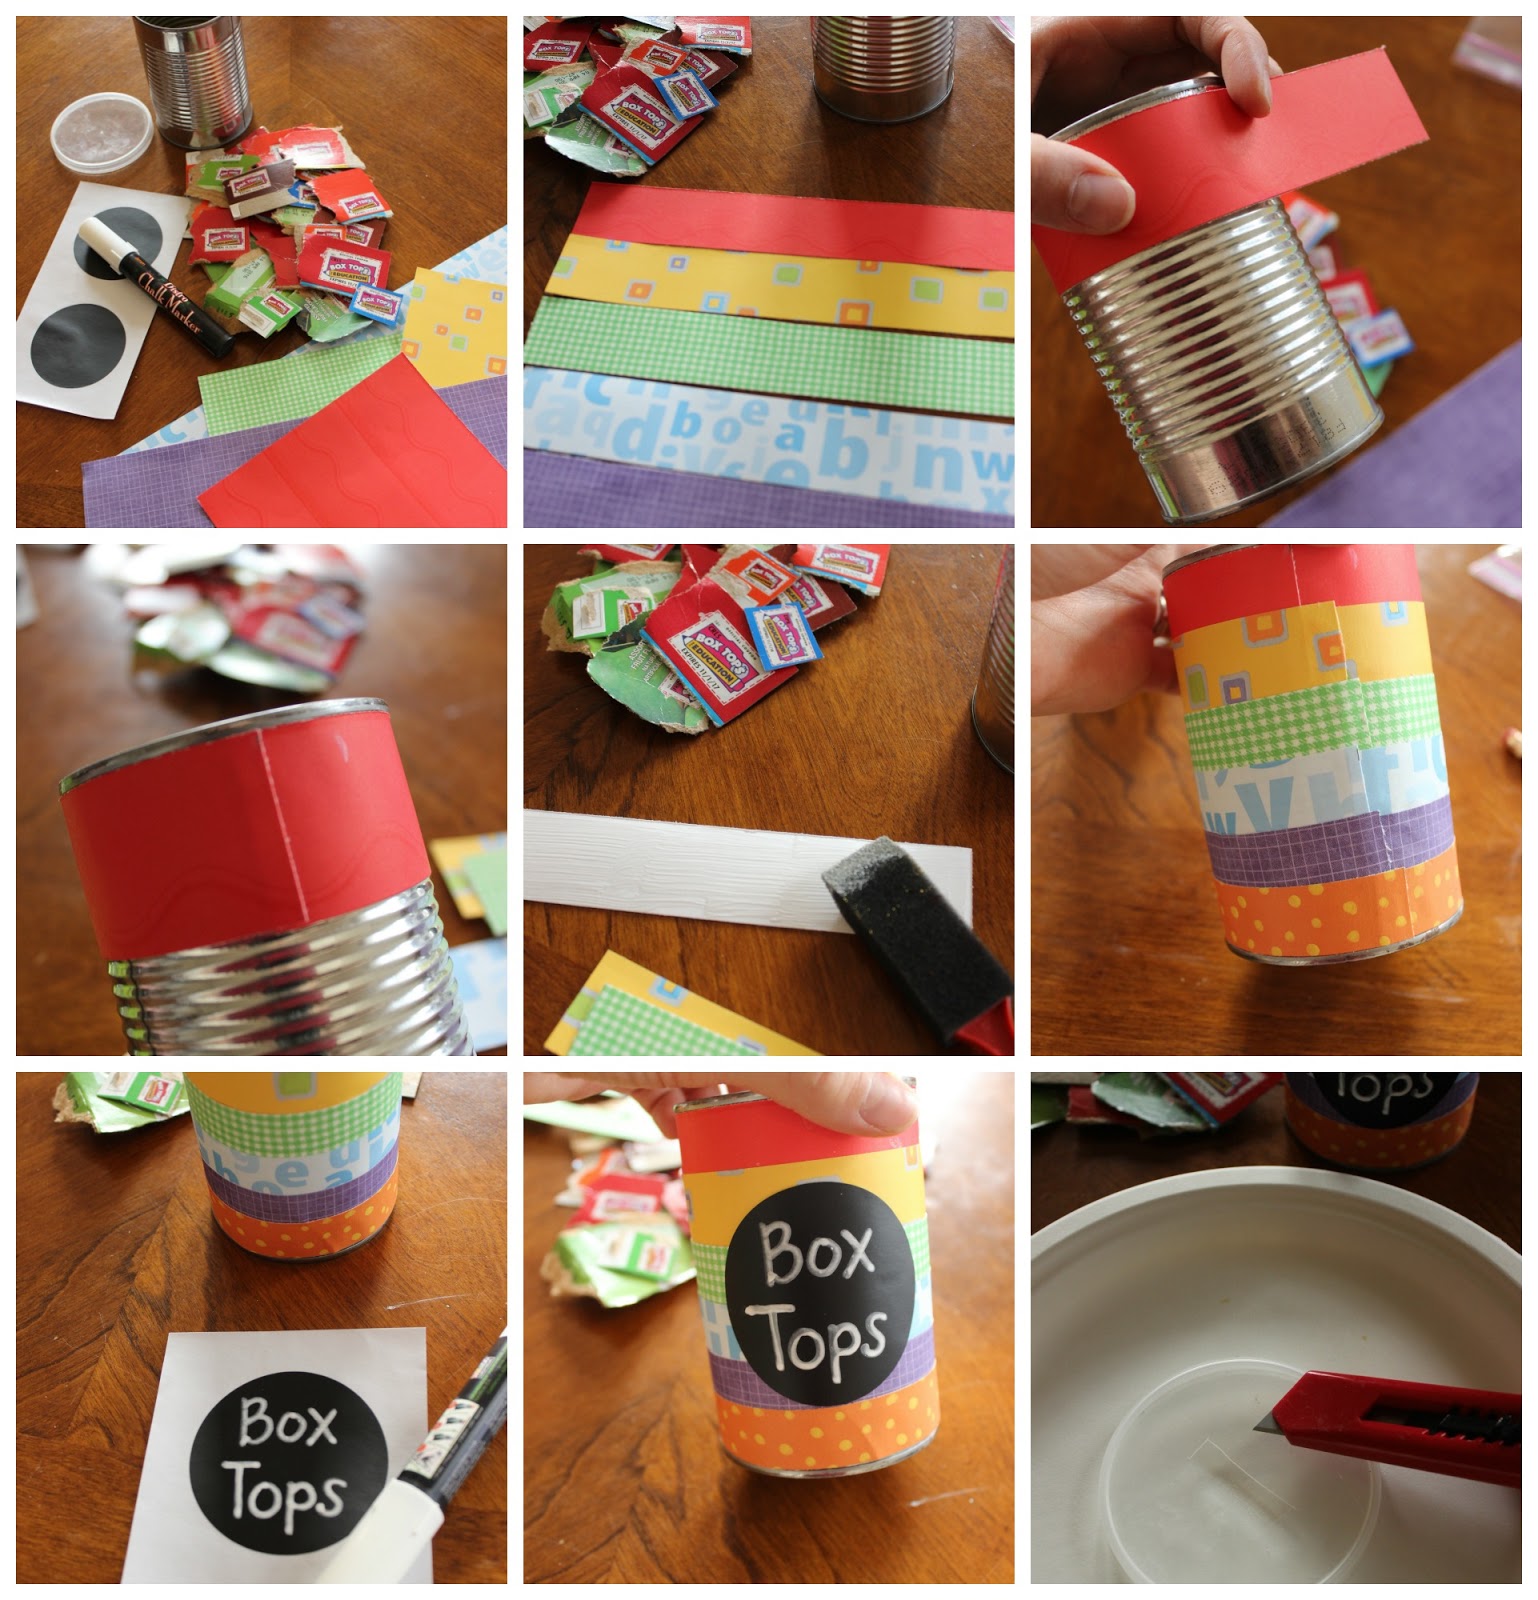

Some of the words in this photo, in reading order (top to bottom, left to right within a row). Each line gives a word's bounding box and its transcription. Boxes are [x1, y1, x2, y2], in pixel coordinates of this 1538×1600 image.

[619, 109, 657, 134] EDUCATION
[621, 101, 643, 112] BOX
[643, 108, 667, 130] TOPS
[329, 263, 347, 271] BOX
[348, 263, 371, 276] TOPS
[332, 271, 368, 282] EDUCATION
[138, 271, 168, 305] Chalk
[165, 295, 201, 335] Marker
[767, 621, 788, 655] EDUCATION
[772, 615, 790, 632] BOX
[785, 631, 799, 654] TOPS
[681, 647, 702, 670] EXPIRES
[700, 668, 720, 690] 11/1/17
[692, 643, 734, 683] EDUCATION
[696, 633, 723, 652] BOX
[721, 647, 750, 679] TOPS
[759, 1220, 876, 1288] Box
[744, 1302, 888, 1385] Tops
[239, 1396, 339, 1448] Box
[220, 1459, 349, 1537] Tops
